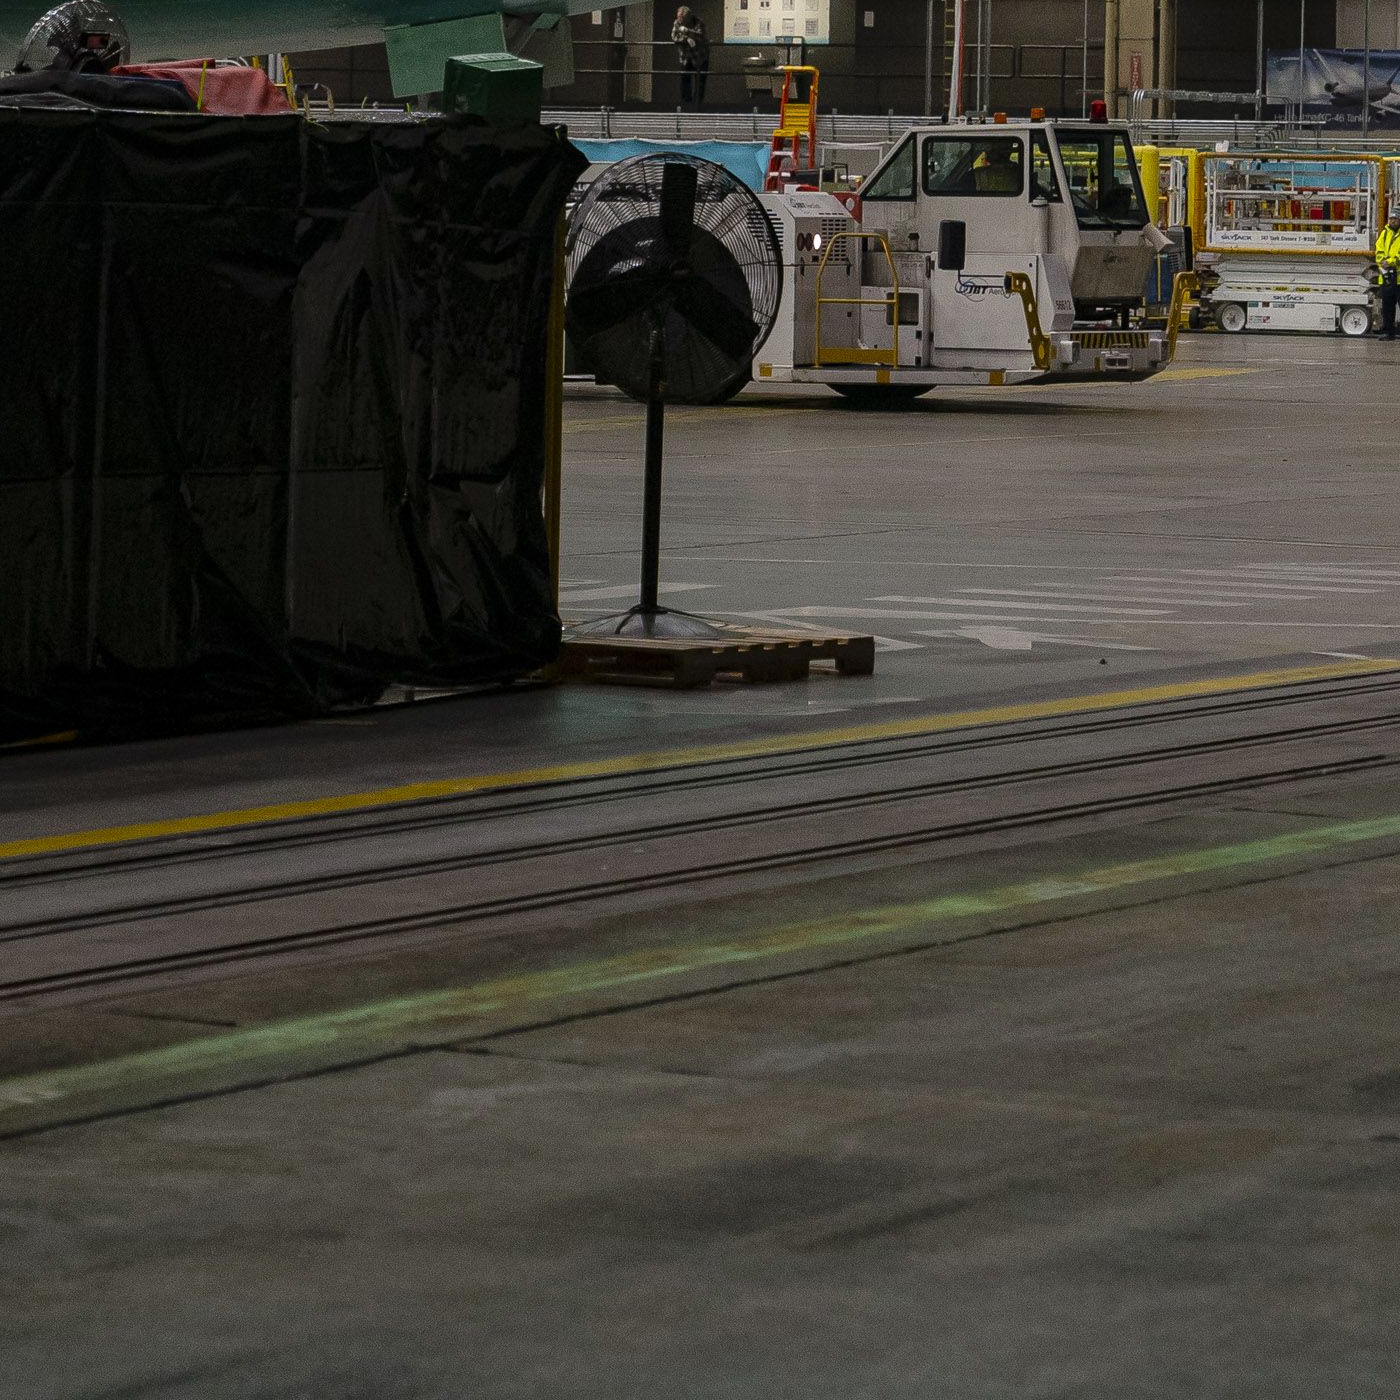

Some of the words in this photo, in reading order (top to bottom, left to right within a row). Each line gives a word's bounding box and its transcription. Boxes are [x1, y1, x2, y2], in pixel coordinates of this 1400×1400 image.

[1347, 113, 1371, 123] Tankr
[1221, 233, 1252, 241] SKYJACK
[1273, 294, 1305, 302] SKYJACK
